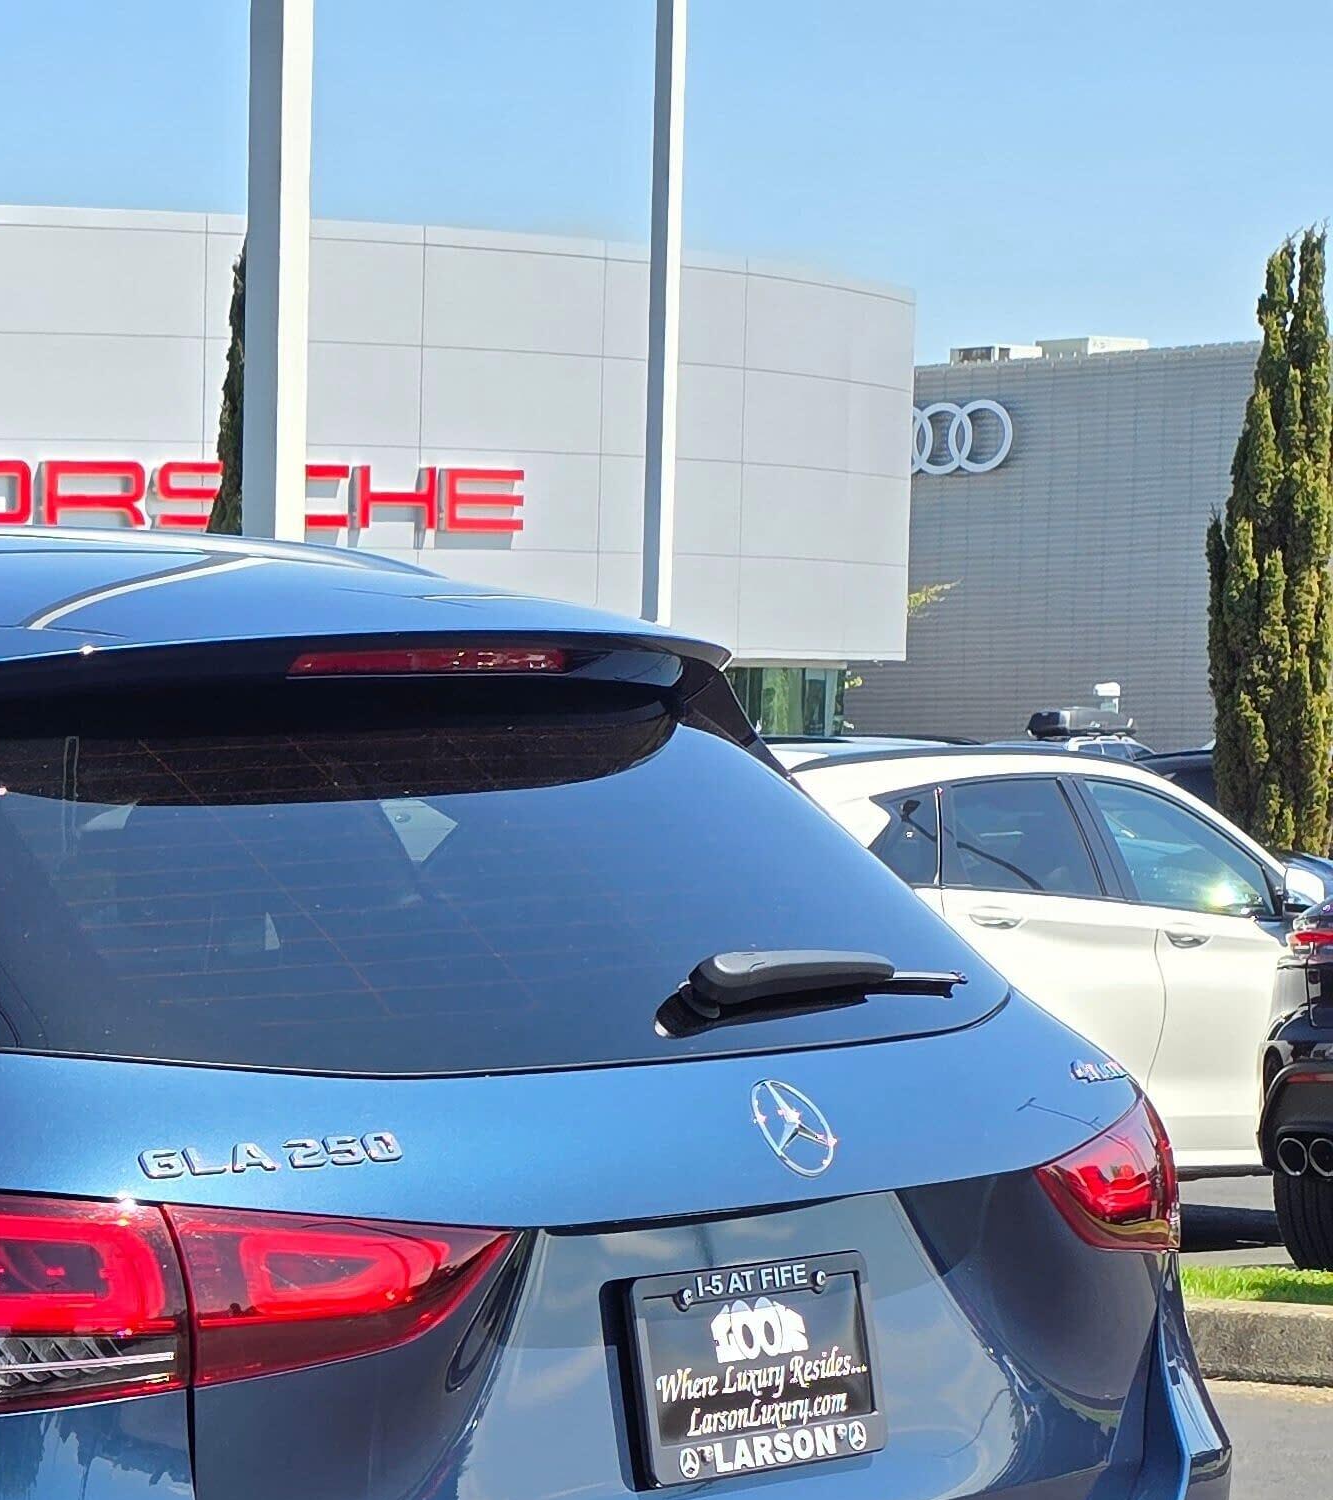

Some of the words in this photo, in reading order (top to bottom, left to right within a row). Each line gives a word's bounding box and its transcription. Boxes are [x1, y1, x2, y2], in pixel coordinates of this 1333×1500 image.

[137, 1142, 278, 1180] GLA
[282, 1131, 404, 1170] 250
[696, 1274, 724, 1298] I-5
[729, 1270, 753, 1294] AT
[760, 1263, 808, 1290] FIFE
[656, 1367, 719, 1403] Where
[721, 1365, 785, 1399] Luxury
[789, 1346, 868, 1389] Resides...
[686, 1391, 848, 1438] LarsonLuxury.com
[712, 1425, 838, 1473] LARSON
